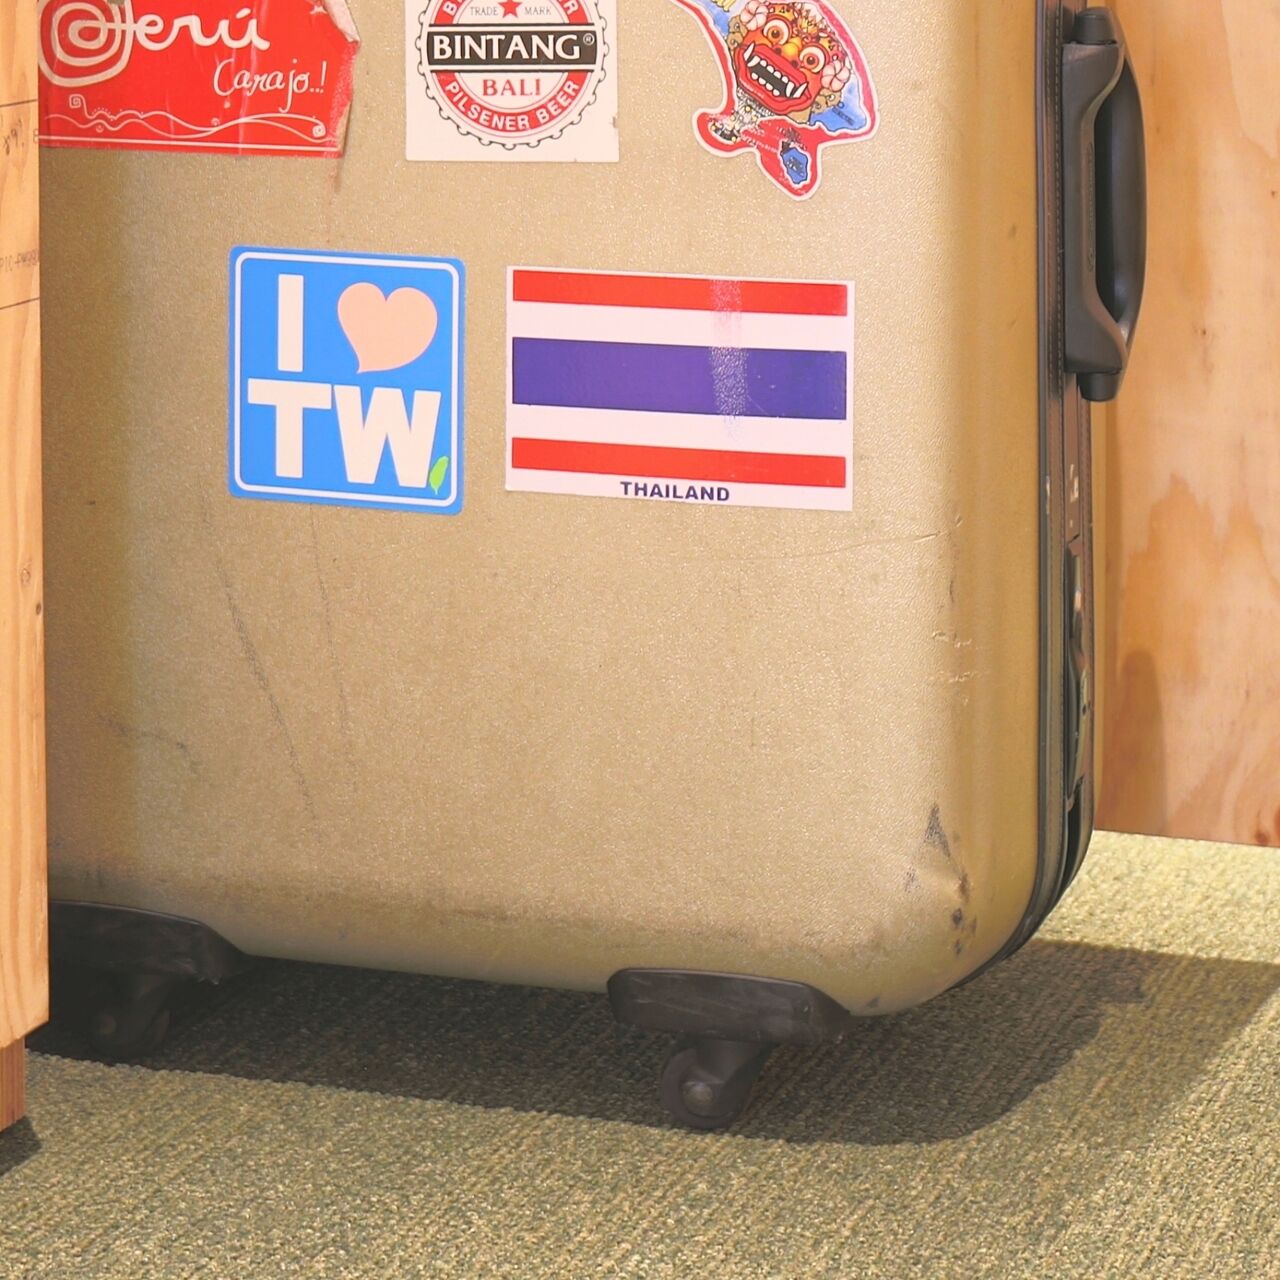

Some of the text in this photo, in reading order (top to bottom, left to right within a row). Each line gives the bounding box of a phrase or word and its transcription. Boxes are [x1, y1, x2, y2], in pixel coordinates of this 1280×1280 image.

[470, 6, 552, 17] TRADE MARK
[433, 34, 581, 60] BINTANG
[482, 78, 542, 97] BALI
[445, 80, 580, 131] PILSENER BEER
[277, 273, 304, 373] I
[247, 377, 442, 489] TW
[620, 480, 730, 503] THAILAND
